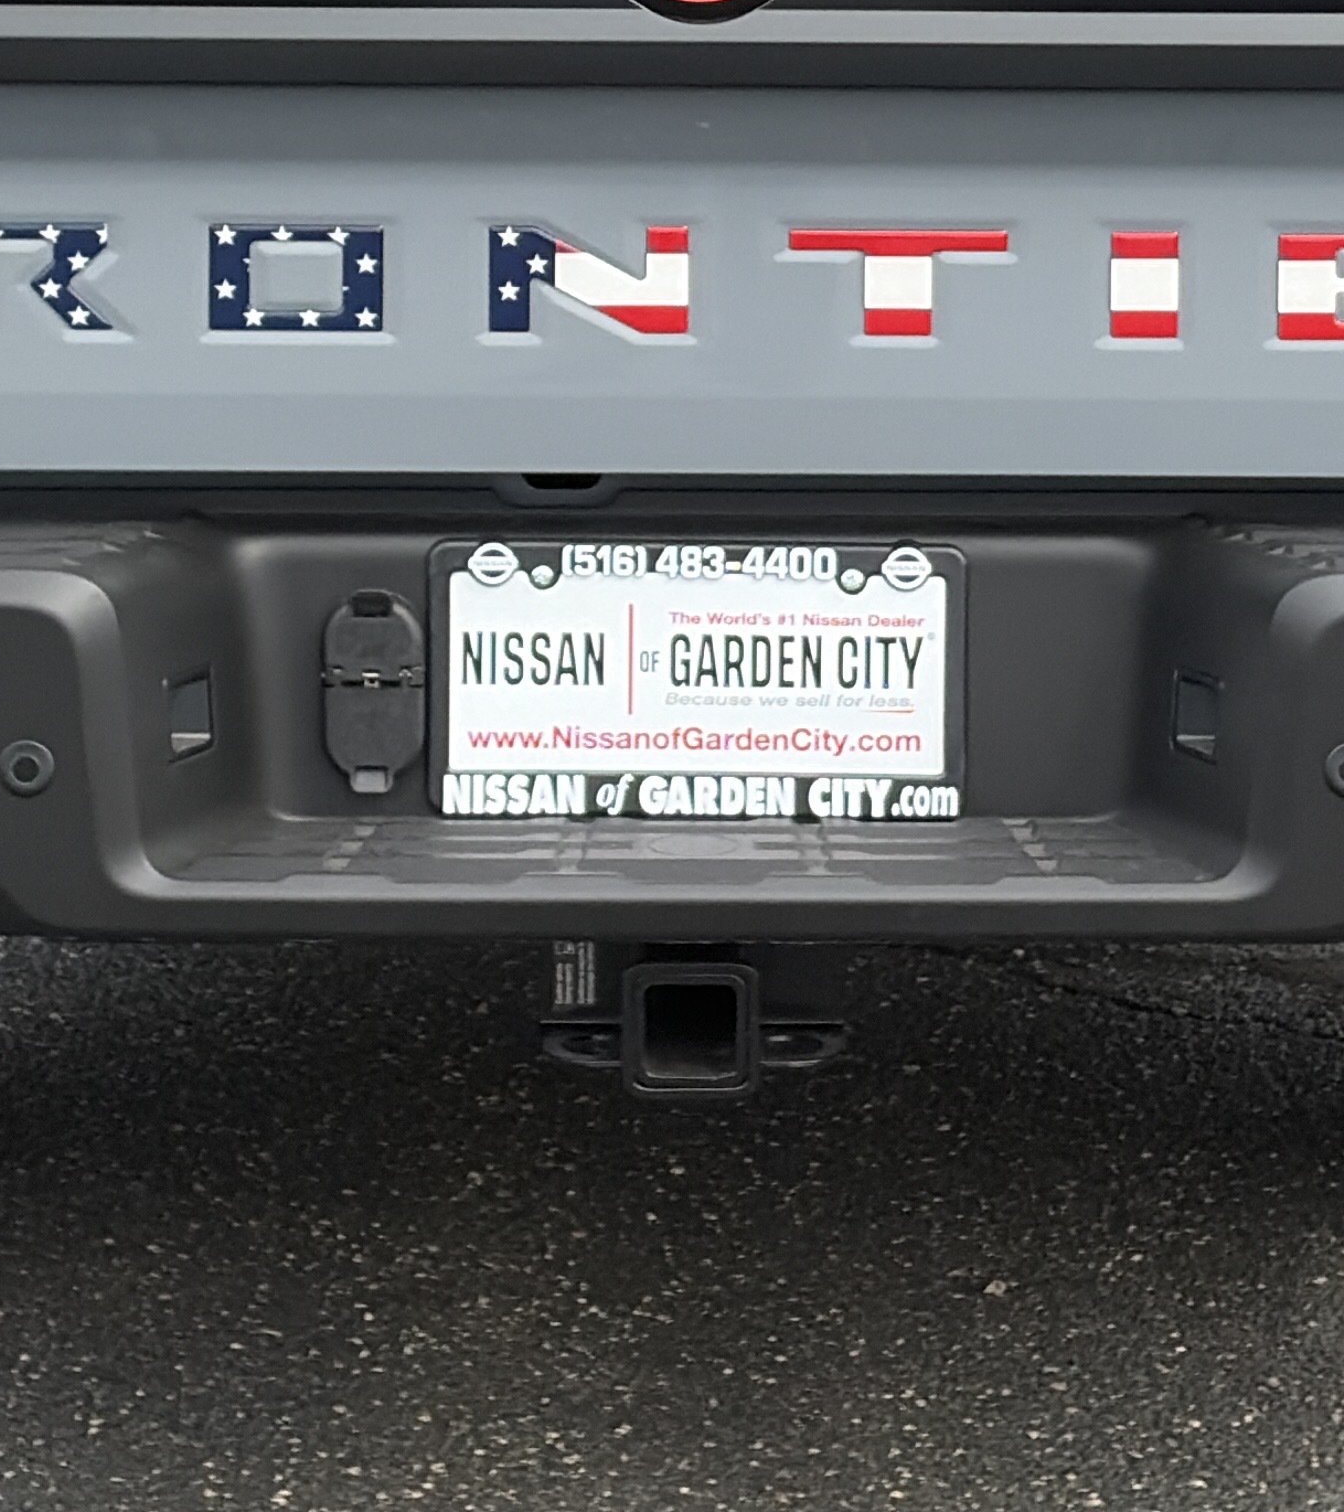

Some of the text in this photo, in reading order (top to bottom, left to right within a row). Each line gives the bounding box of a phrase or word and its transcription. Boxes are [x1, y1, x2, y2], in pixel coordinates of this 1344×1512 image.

[561, 544, 837, 581] (516) 483-4400
[669, 611, 925, 628] The World's #1 Nissan Dealer
[462, 631, 605, 686] NISSAN
[639, 651, 660, 673] OF
[670, 633, 924, 689] GARDEN CITY
[665, 692, 753, 706] Because
[758, 696, 789, 707] we
[796, 694, 830, 707] sell
[836, 694, 863, 708] for
[467, 726, 922, 756] www.NissanofGardenCity.com
[442, 774, 959, 818] NISSAN of GARDEN CITY.com
